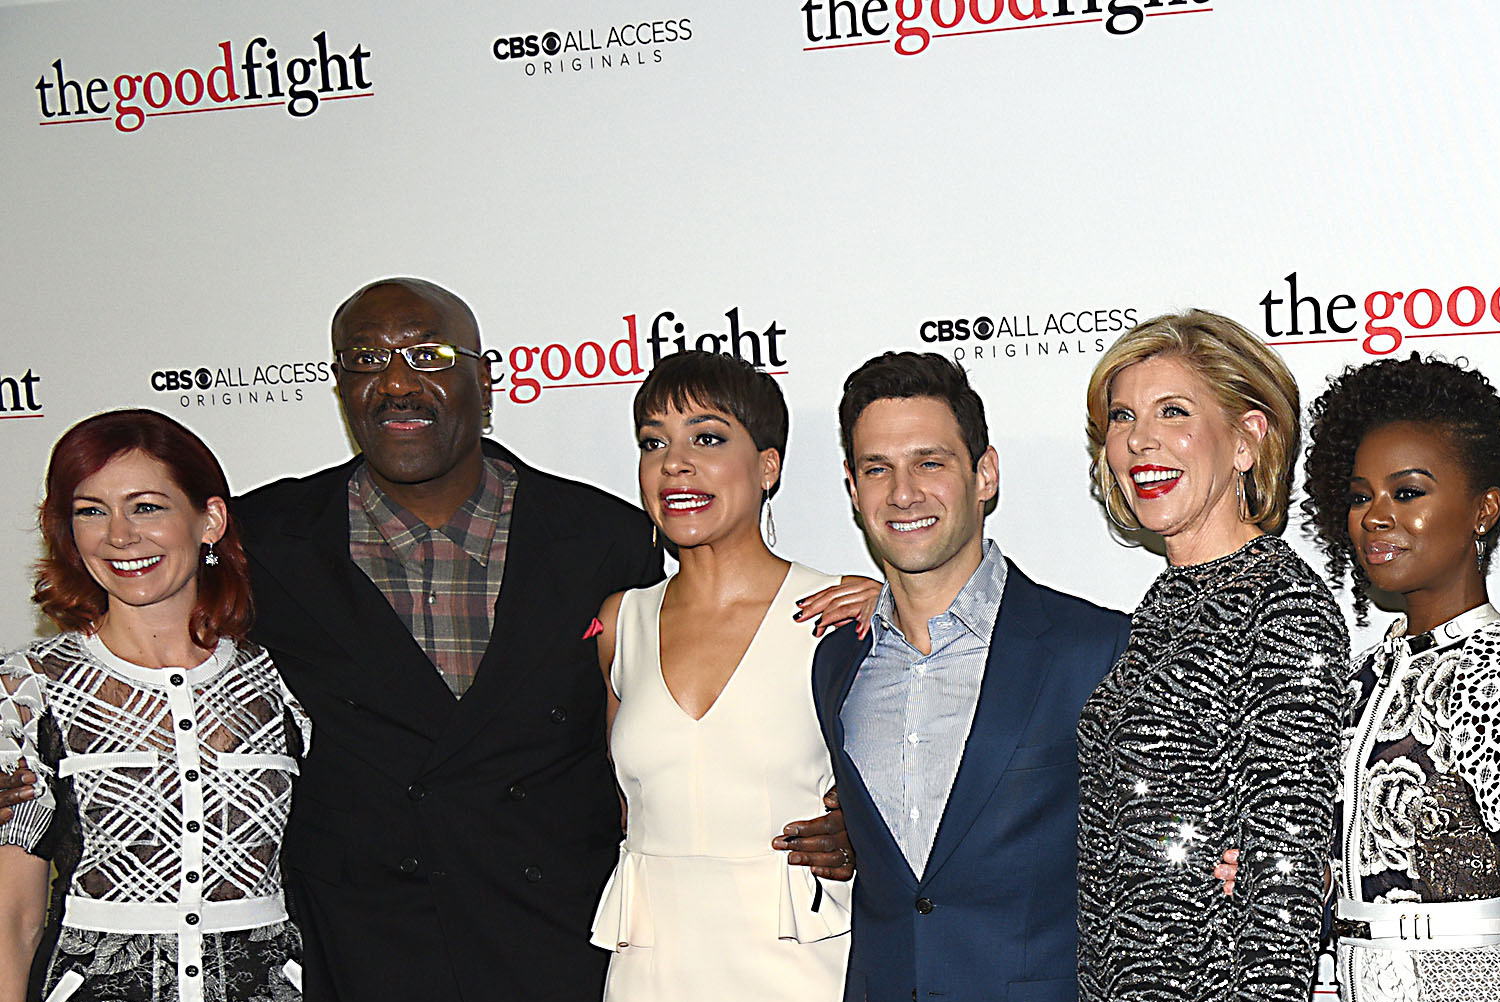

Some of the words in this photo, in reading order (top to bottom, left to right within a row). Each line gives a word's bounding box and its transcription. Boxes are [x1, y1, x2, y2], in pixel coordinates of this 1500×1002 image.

[493, 35, 538, 60] CBS
[563, 29, 602, 53] ALL
[606, 18, 693, 48] ACCESS
[525, 49, 663, 76] ORIGINALS
[920, 318, 971, 343] CBS
[996, 315, 1039, 338] ALL
[1044, 308, 1139, 334] ACCESS
[954, 338, 1105, 361] ORIGINALS
[151, 370, 192, 392] CBS
[214, 367, 250, 388] ALL
[253, 362, 330, 386] ACCESS
[180, 388, 304, 408] ORIGINALS
